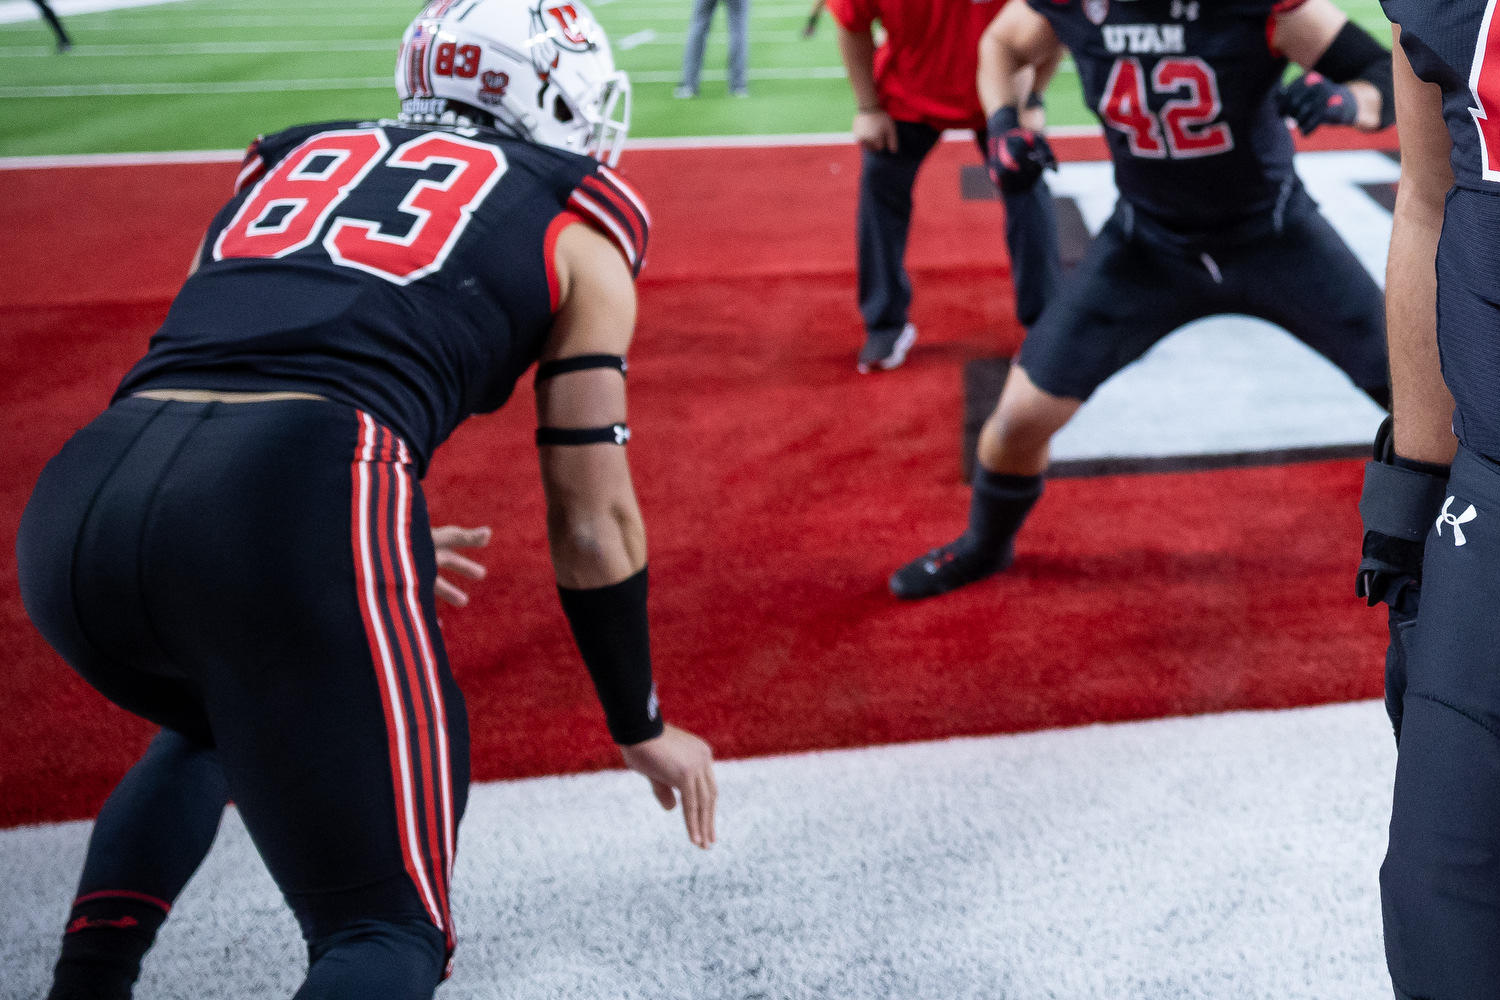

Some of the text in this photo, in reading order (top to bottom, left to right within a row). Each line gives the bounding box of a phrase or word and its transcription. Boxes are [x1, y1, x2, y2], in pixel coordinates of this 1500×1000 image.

[436, 42, 481, 79] 83
[1101, 24, 1186, 53] UTAH
[1098, 56, 1234, 160] 42
[213, 128, 509, 286] 83
